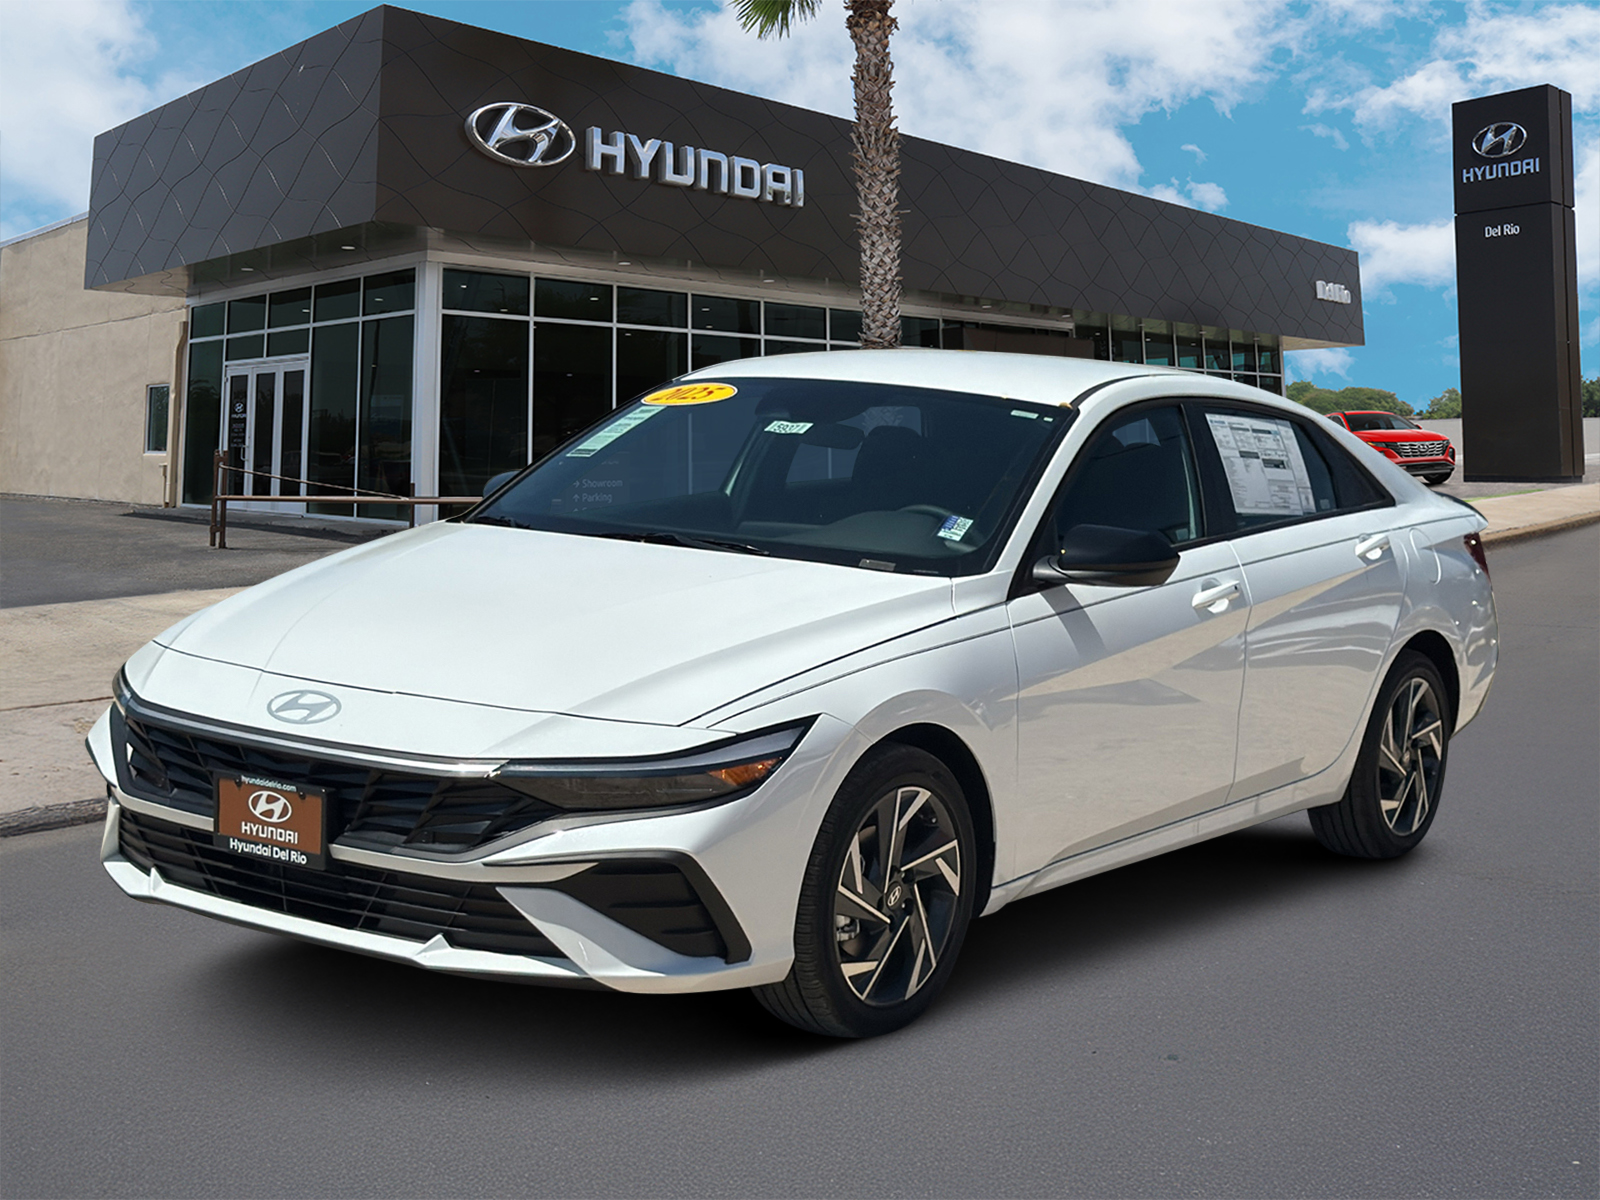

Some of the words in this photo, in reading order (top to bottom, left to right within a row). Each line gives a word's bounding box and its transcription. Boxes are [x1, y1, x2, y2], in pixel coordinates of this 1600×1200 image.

[585, 126, 804, 207] HYUNDAI
[1462, 157, 1540, 183] HYUNDAI
[1485, 225, 1501, 238] Del
[1503, 223, 1520, 236] Rio
[650, 386, 726, 402] 2025
[582, 479, 623, 489] Showroom
[582, 493, 612, 504] Parking
[241, 821, 298, 844] HYUNDAI
[229, 838, 272, 857] Hyundai
[273, 847, 289, 861] Del
[290, 851, 307, 864] Rio
